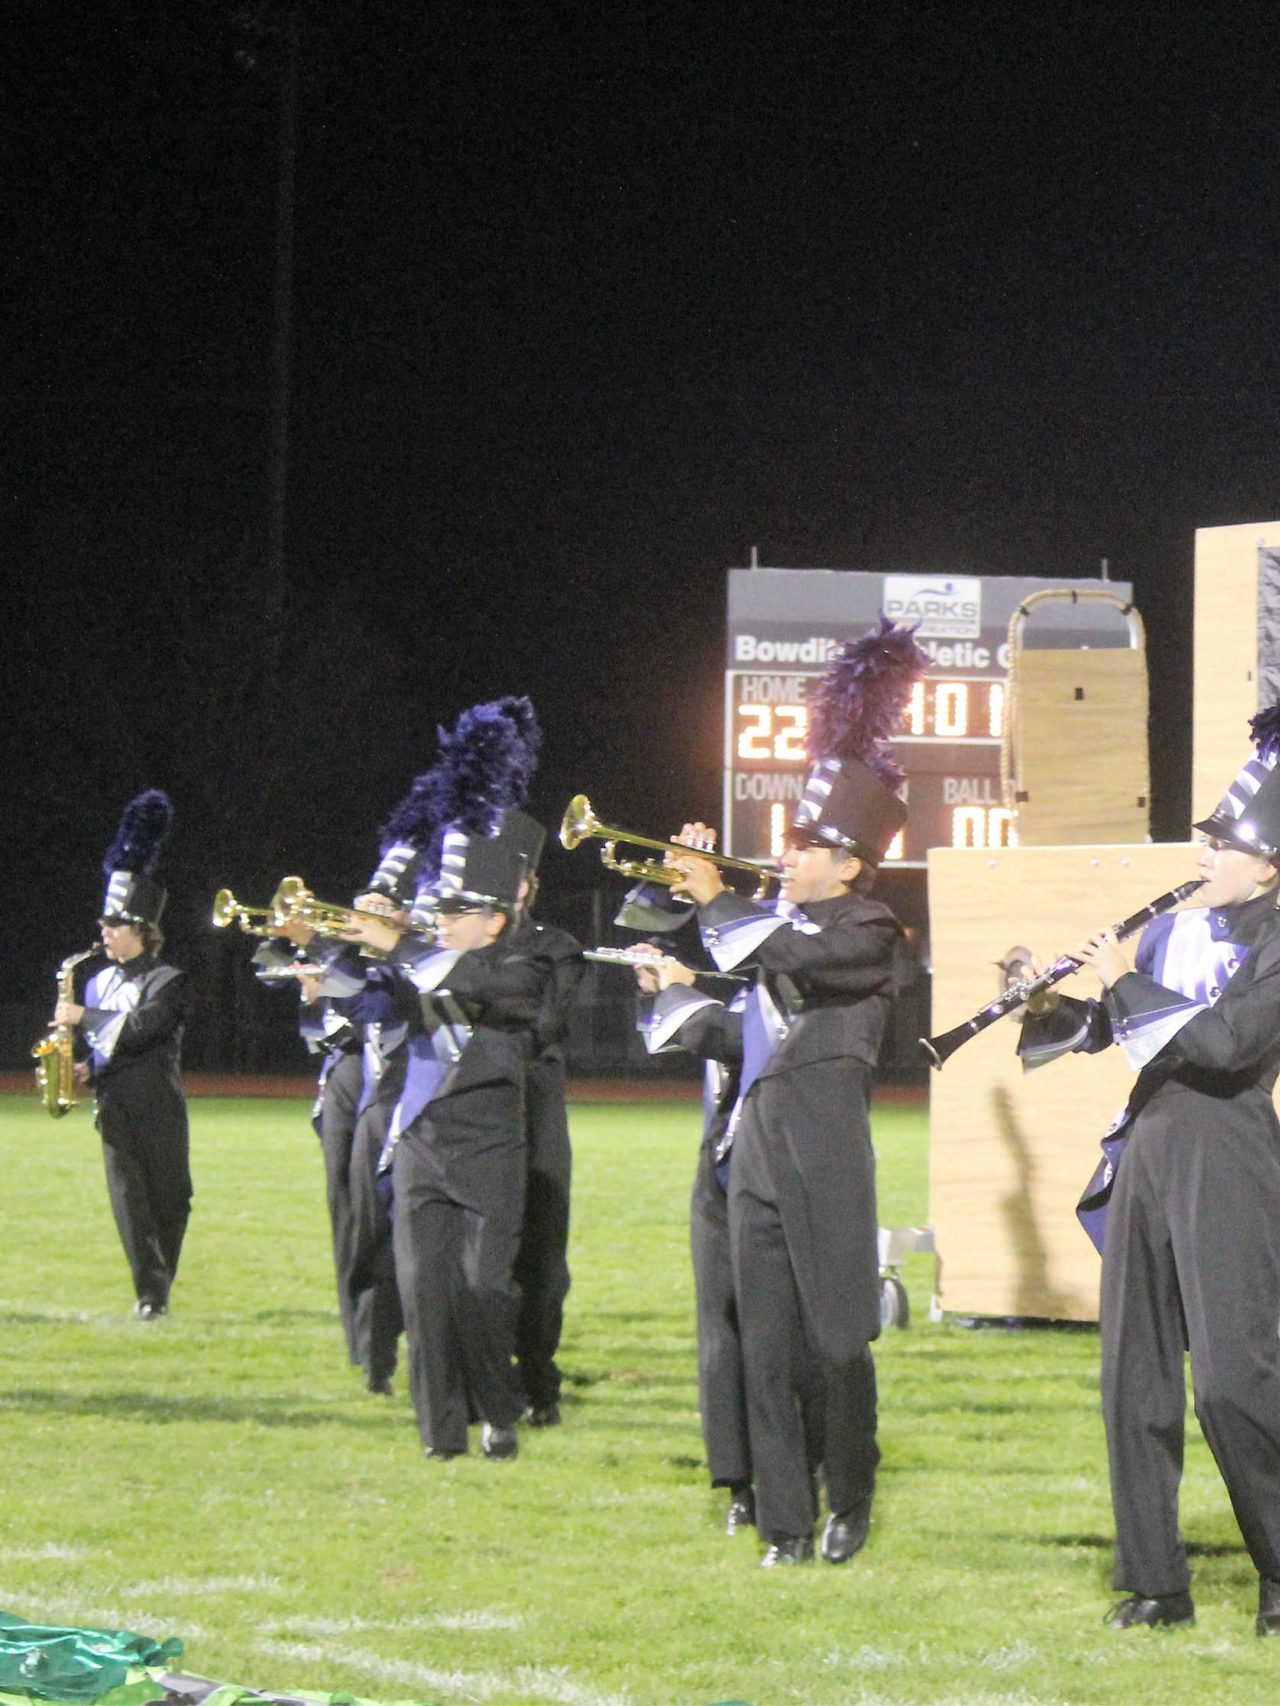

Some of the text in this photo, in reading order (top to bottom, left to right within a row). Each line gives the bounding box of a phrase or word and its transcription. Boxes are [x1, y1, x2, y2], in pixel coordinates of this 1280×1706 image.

[886, 600, 978, 618] PARKS
[735, 635, 846, 663] Bowdi
[741, 675, 807, 703] HOME
[738, 704, 808, 760] 22
[734, 772, 804, 801] DOWN
[943, 777, 999, 805] BALL
